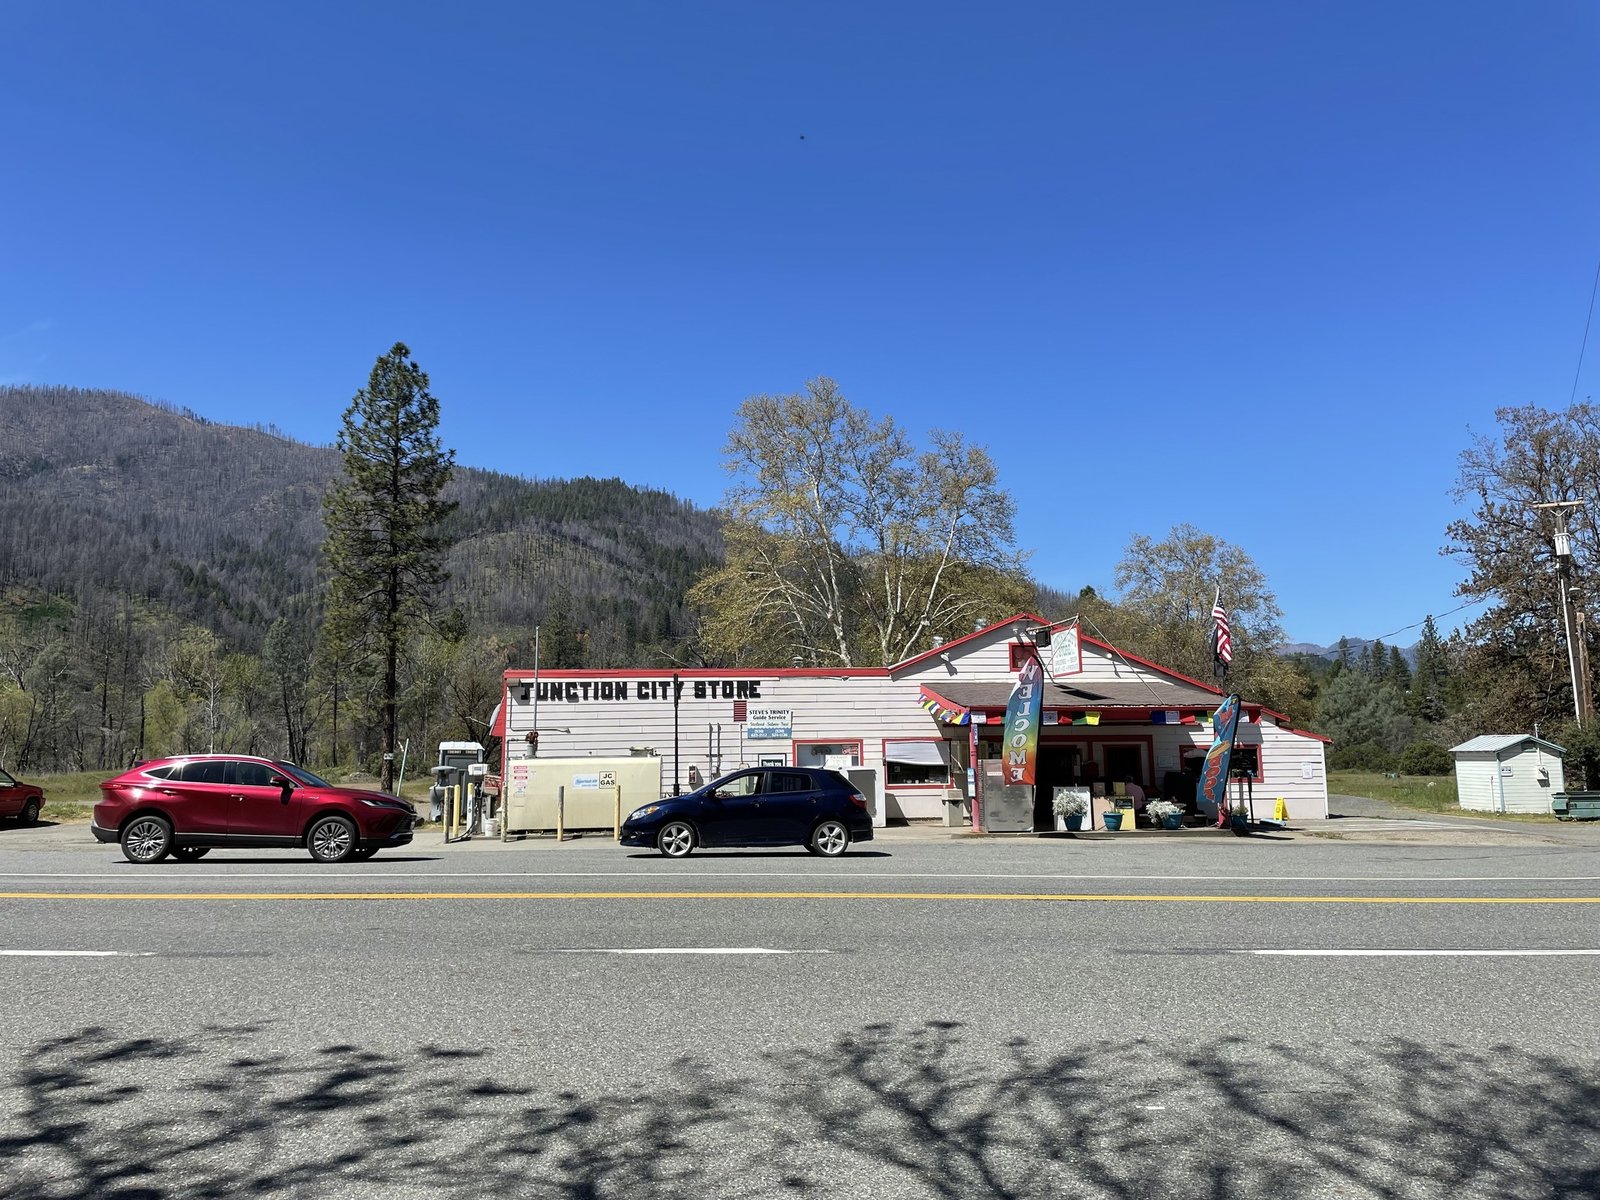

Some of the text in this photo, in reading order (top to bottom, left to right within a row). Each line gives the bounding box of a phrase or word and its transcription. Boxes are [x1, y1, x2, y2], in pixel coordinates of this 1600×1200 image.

[520, 680, 761, 702] JUNCTION CITY STORE
